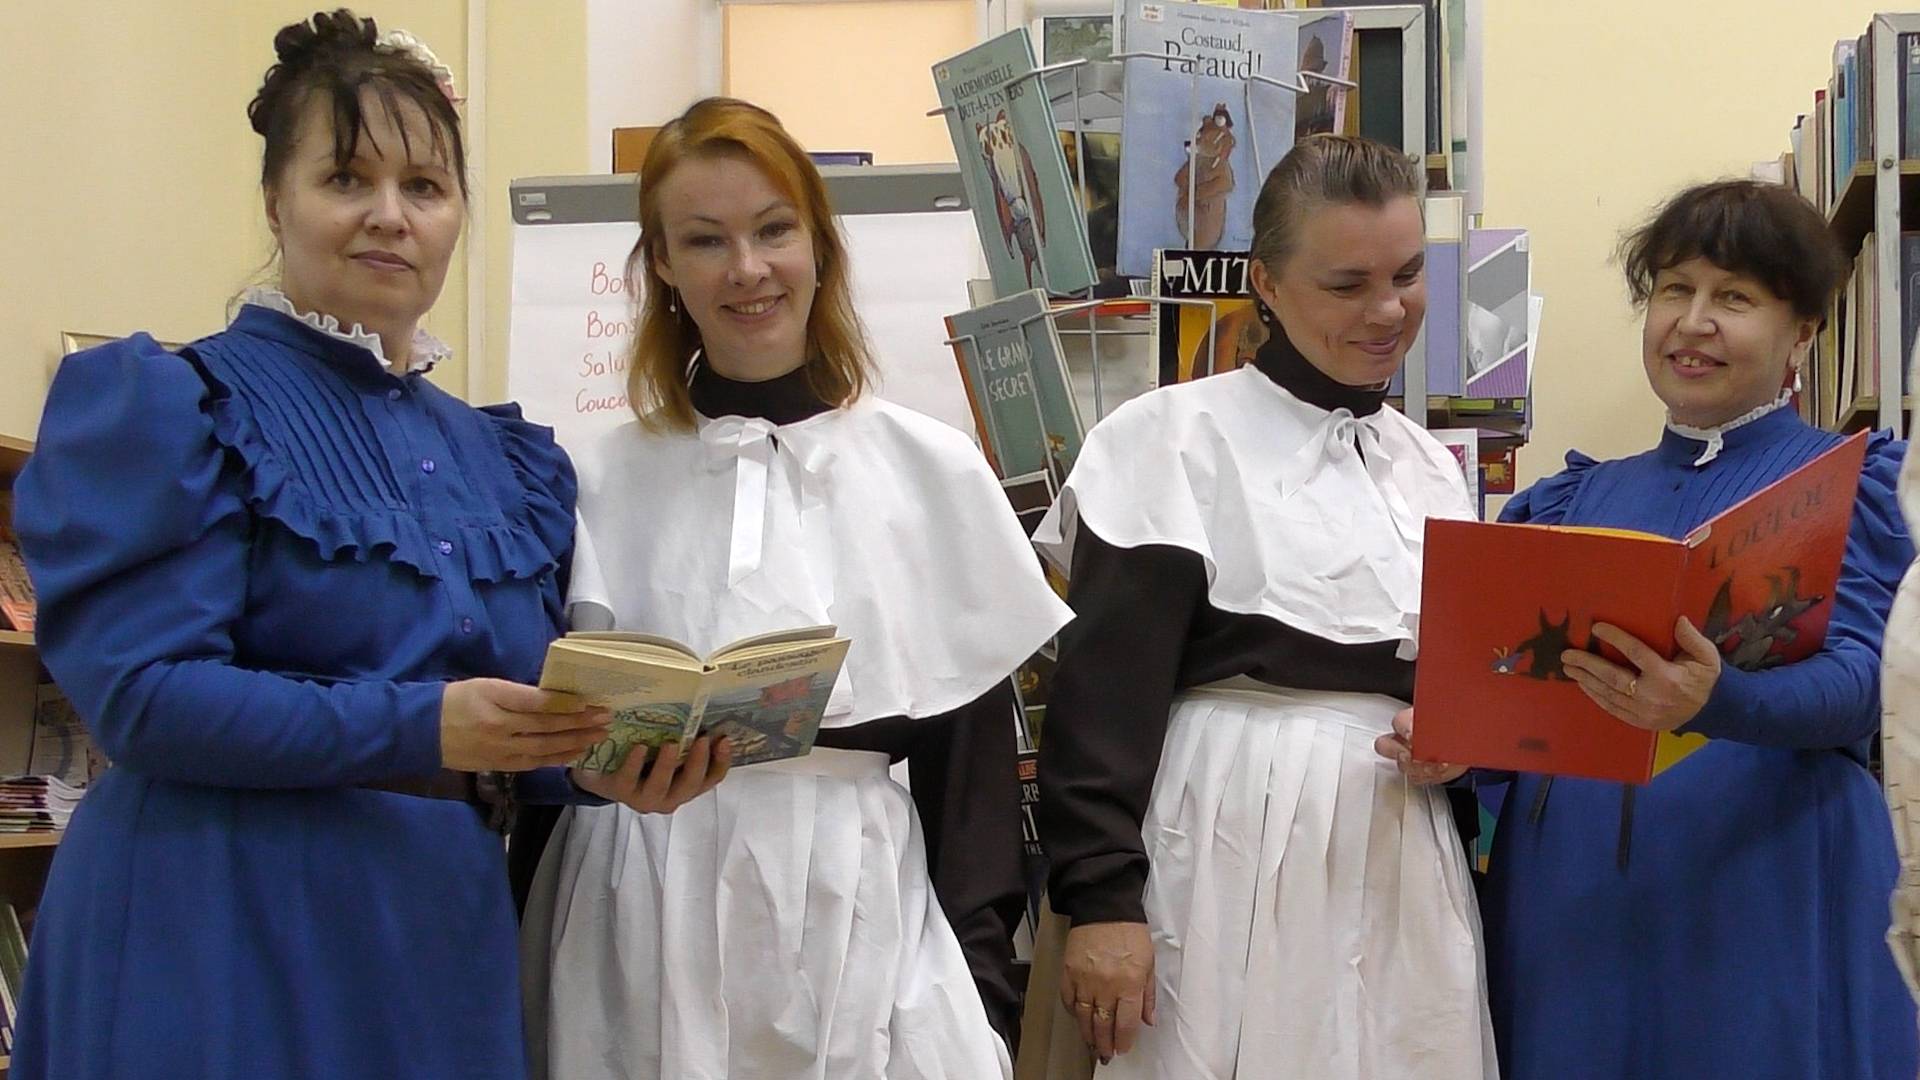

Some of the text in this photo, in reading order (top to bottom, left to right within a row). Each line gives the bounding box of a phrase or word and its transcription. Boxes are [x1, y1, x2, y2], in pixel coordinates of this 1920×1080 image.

[1181, 27, 1245, 54] Costaud,
[952, 64, 1014, 99] MADEMOISELLE
[982, 341, 1033, 371] LE GRAND
